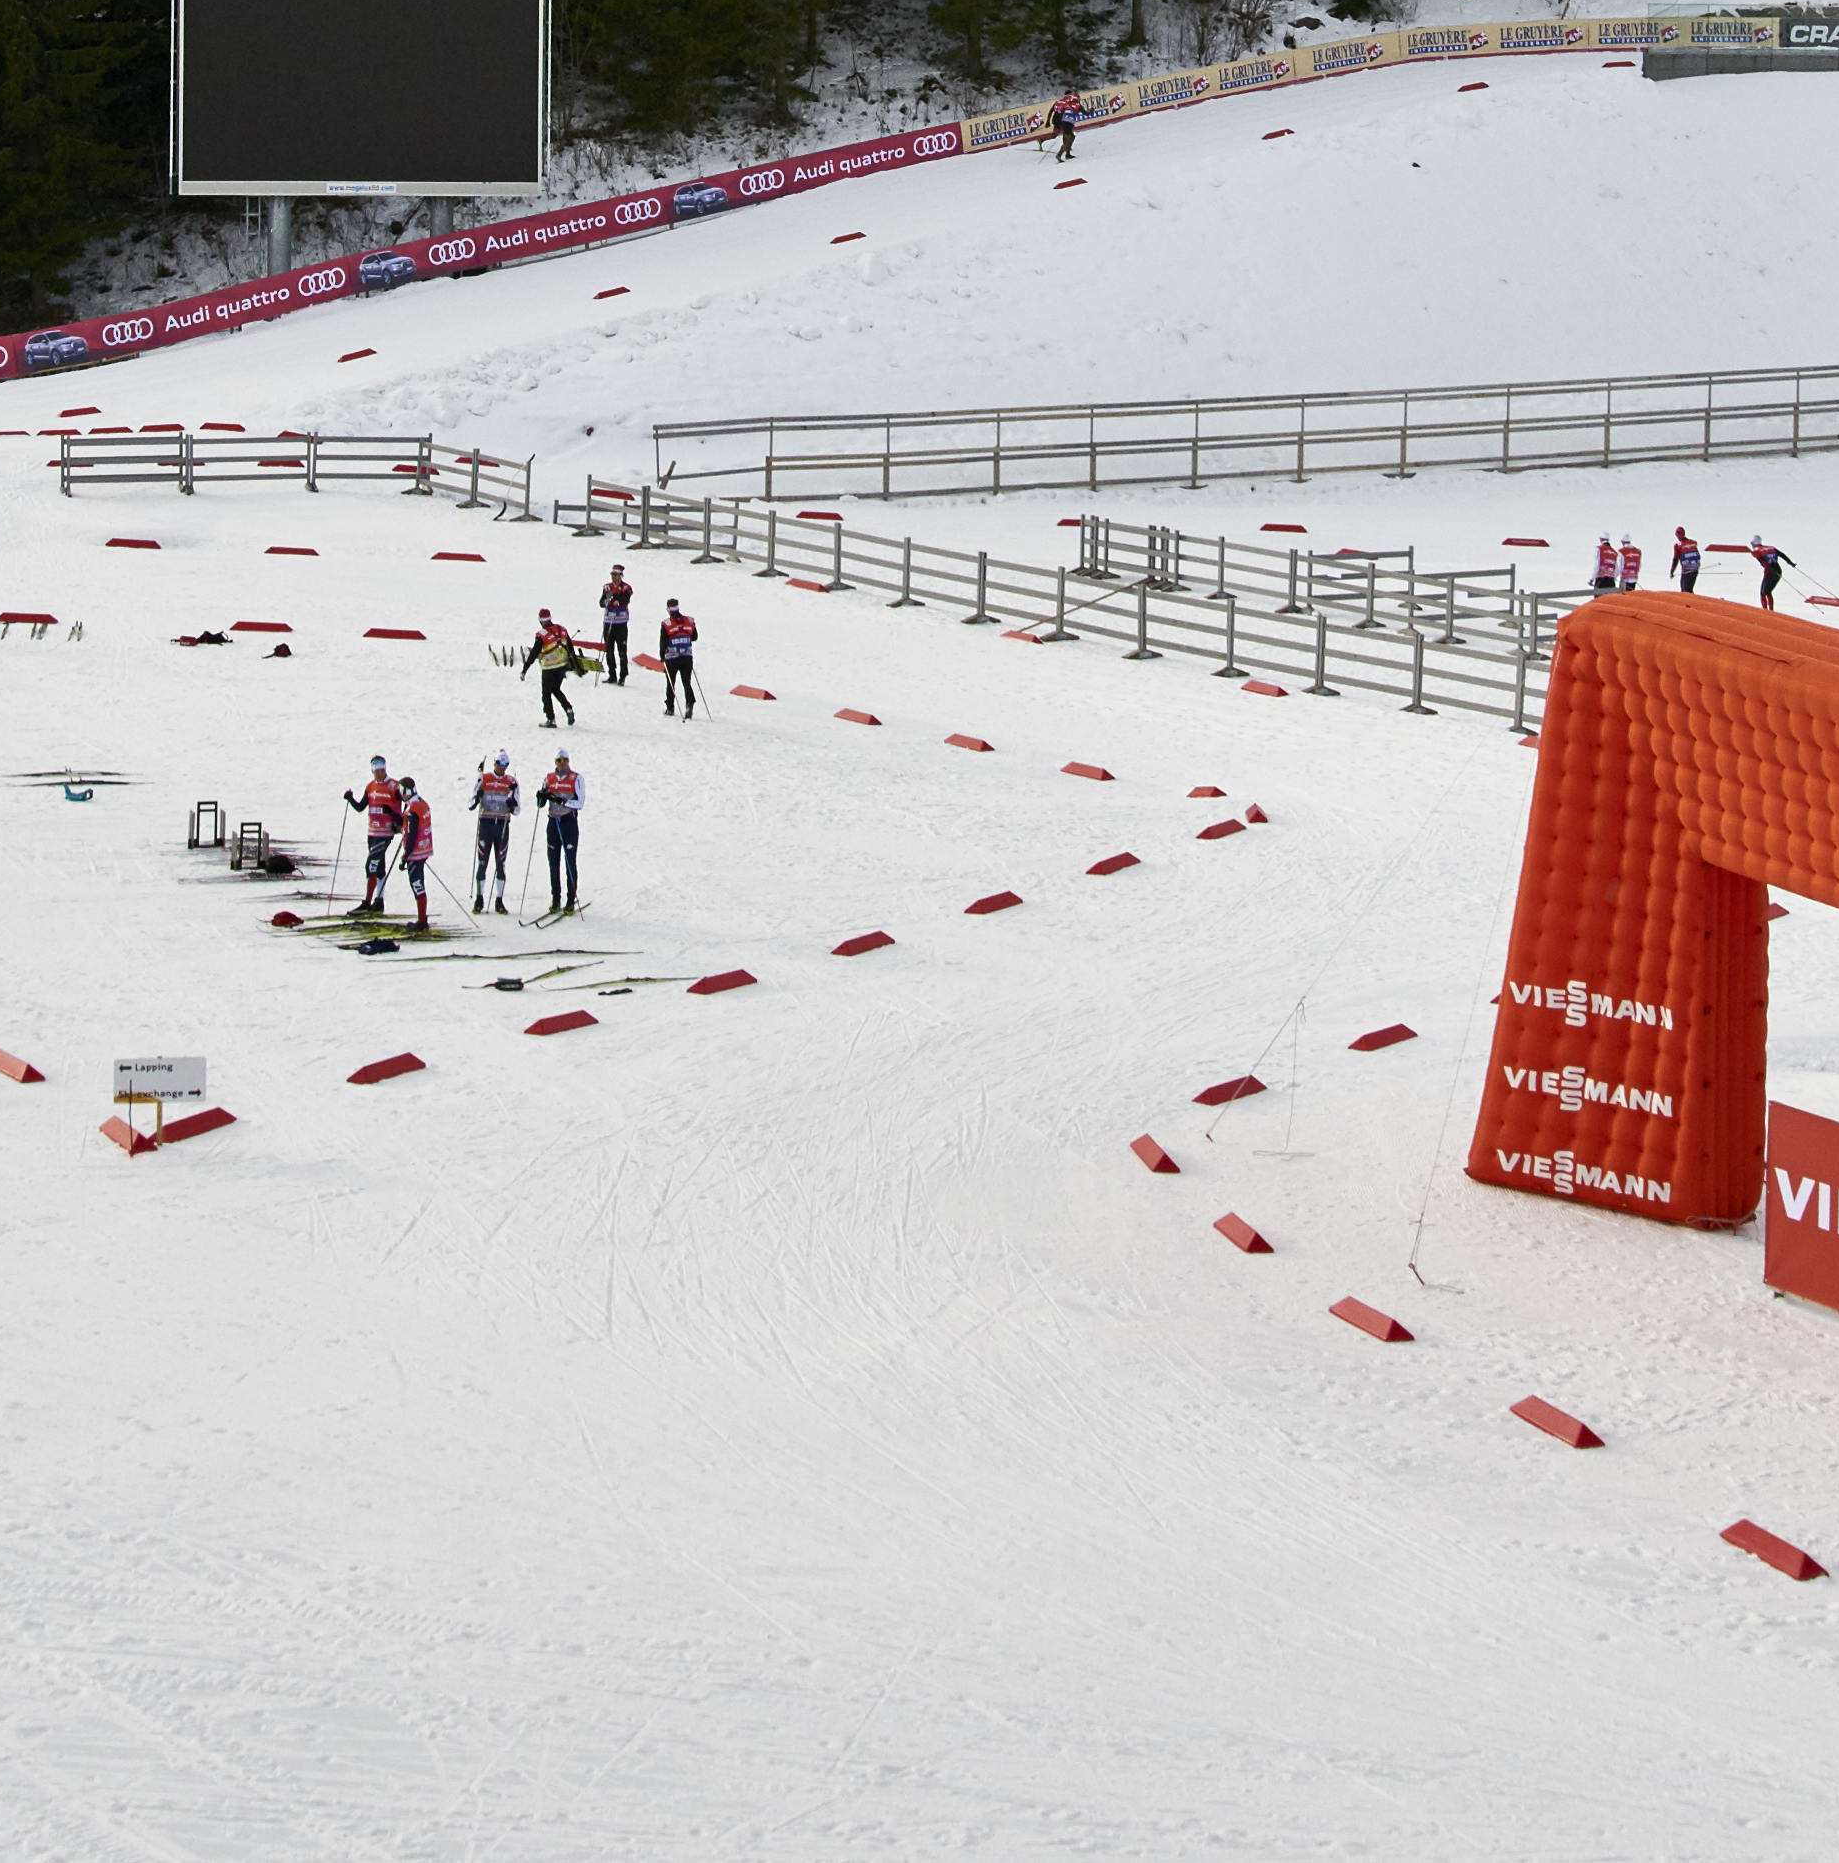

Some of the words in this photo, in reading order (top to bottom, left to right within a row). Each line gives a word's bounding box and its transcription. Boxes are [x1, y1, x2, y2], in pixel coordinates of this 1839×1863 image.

[1500, 27, 1515, 41] LE
[1598, 24, 1610, 37] LE
[1691, 22, 1703, 35] LE
[1408, 34, 1418, 47] LE
[1313, 50, 1324, 63] LE
[1218, 68, 1231, 83] LE
[1138, 85, 1150, 100] LE
[969, 124, 982, 138] LE
[793, 160, 834, 182] Audi
[839, 147, 905, 173] quattro
[485, 228, 528, 252] Audi
[534, 215, 607, 243] quattro
[165, 306, 210, 332] Audi
[216, 288, 290, 319] quattro
[1509, 980, 1674, 1031] VIESSMANN
[135, 1063, 174, 1073] Lapping
[136, 1090, 184, 1098] exchange
[1503, 1065, 1673, 1118] VIESSMANN
[1496, 1149, 1671, 1203] VIESSMANN
